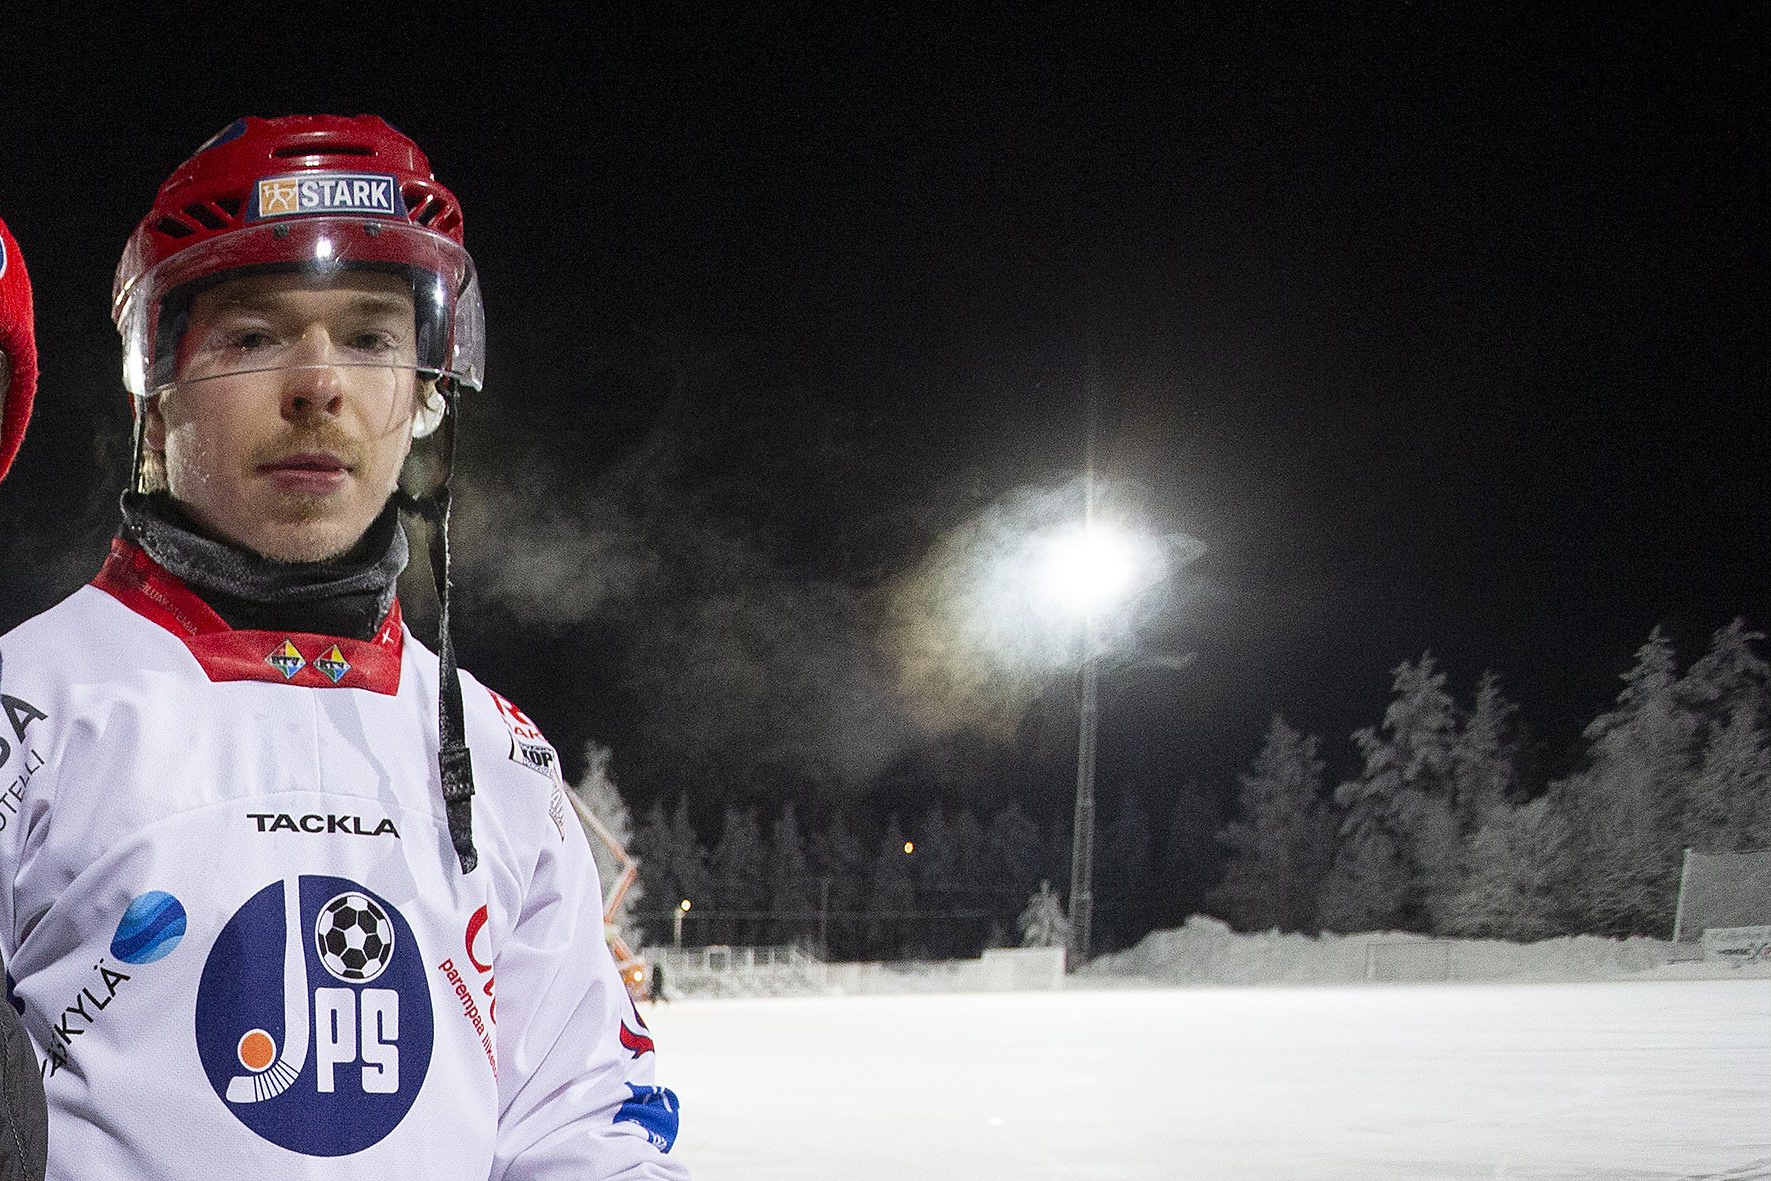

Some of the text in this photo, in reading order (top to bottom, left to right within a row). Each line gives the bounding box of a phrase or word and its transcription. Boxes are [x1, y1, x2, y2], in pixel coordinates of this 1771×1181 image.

[300, 180, 389, 208] STARK
[246, 813, 401, 840] TACKLA
[226, 876, 400, 1103] JPS
[438, 957, 486, 1038] parempaa
